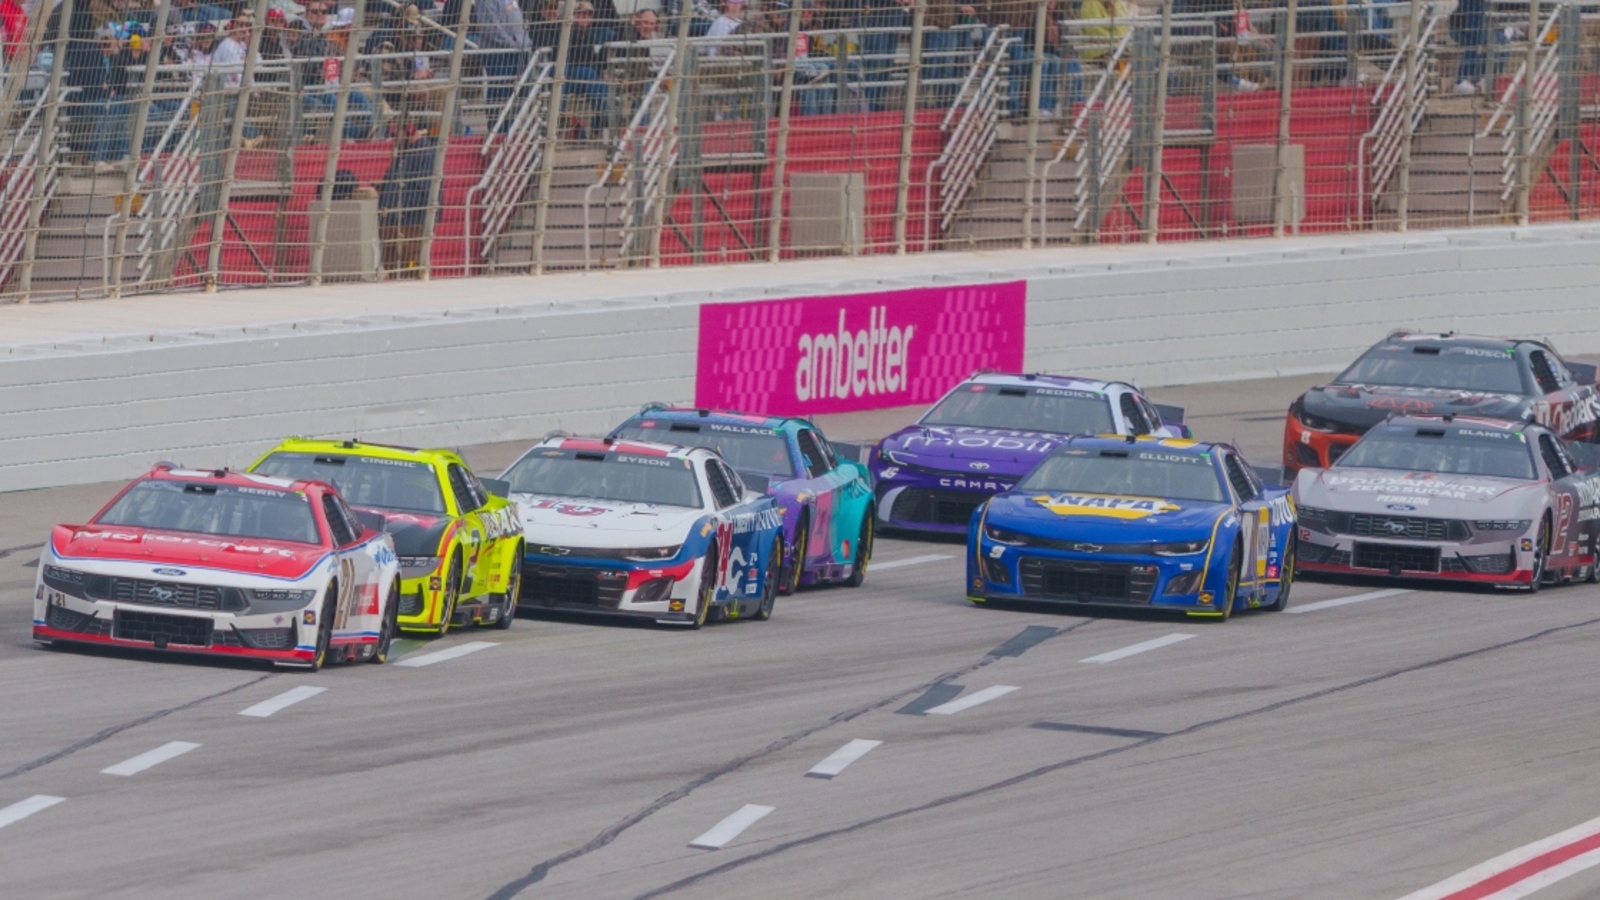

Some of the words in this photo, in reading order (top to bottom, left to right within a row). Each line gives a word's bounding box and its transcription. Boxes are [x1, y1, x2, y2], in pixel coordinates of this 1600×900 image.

[796, 305, 914, 402] ambetter
[1464, 349, 1512, 359] BUSCH
[1036, 388, 1095, 399] REDDICK
[710, 423, 777, 437] WALLACE
[1459, 429, 1512, 440] BLANEY
[903, 436, 1052, 453] mobil
[361, 457, 417, 468] CINDRIC
[617, 455, 671, 467] BYRON
[1139, 452, 1200, 464] ELLIOTT
[940, 478, 1014, 490] CAMRY
[1329, 476, 1497, 496] BODYARMOR
[1349, 484, 1400, 493] ZERO
[238, 486, 287, 498] BERRY
[1059, 495, 1154, 510] NAPA
[1376, 494, 1431, 506] PENNZOIL
[990, 545, 1007, 559] 9
[55, 592, 67, 608] 21
